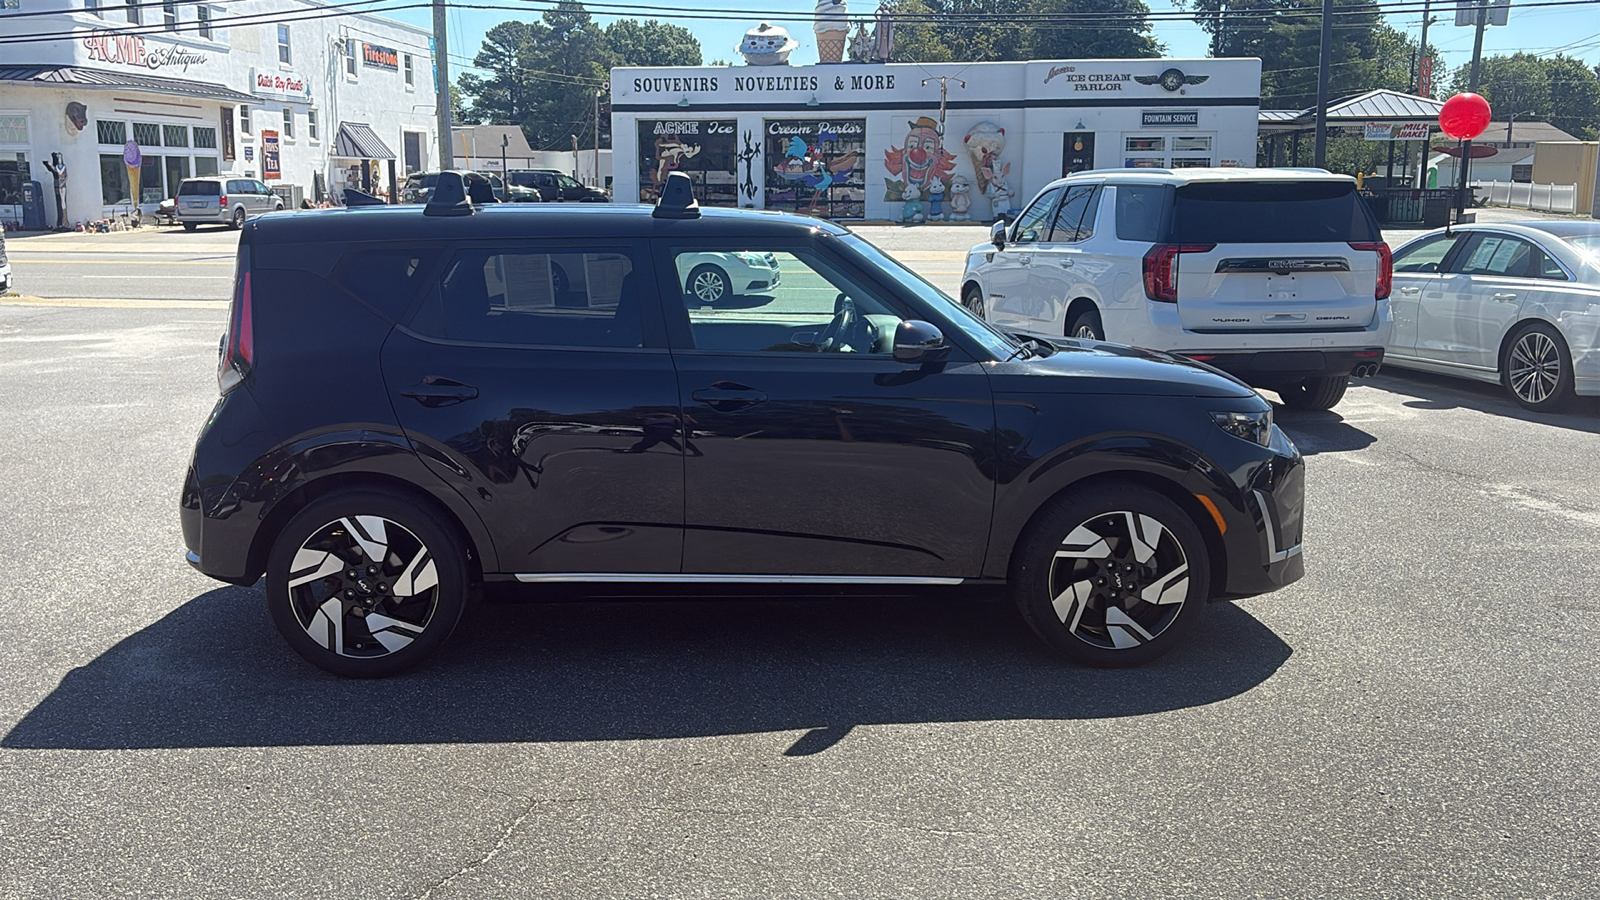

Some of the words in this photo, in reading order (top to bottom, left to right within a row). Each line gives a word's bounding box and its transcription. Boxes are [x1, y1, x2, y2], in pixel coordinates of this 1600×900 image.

[83, 28, 147, 68] ACME
[160, 43, 208, 73] Antiques
[363, 43, 398, 66] Firestone
[257, 73, 273, 88] Dutch
[275, 76, 285, 92] Boy
[286, 77, 303, 91] Paints
[634, 77, 718, 92] SOUVENIRS
[735, 76, 818, 91] NOVELTIES
[834, 76, 845, 91] &
[851, 75, 895, 90] MORE
[1066, 74, 1086, 82] ICE
[1088, 74, 1131, 82] CREAM
[1074, 83, 1122, 91] PARLOR
[1144, 114, 1172, 123] FOUNTAIN
[1173, 114, 1197, 123] SERVICE
[653, 121, 699, 135] ACME
[707, 121, 734, 134] Ice
[769, 121, 812, 134] Cream
[818, 121, 863, 134] Parlor
[1403, 123, 1429, 131] MILK
[1396, 130, 1428, 138] SHAKES
[266, 158, 279, 170] TEA
